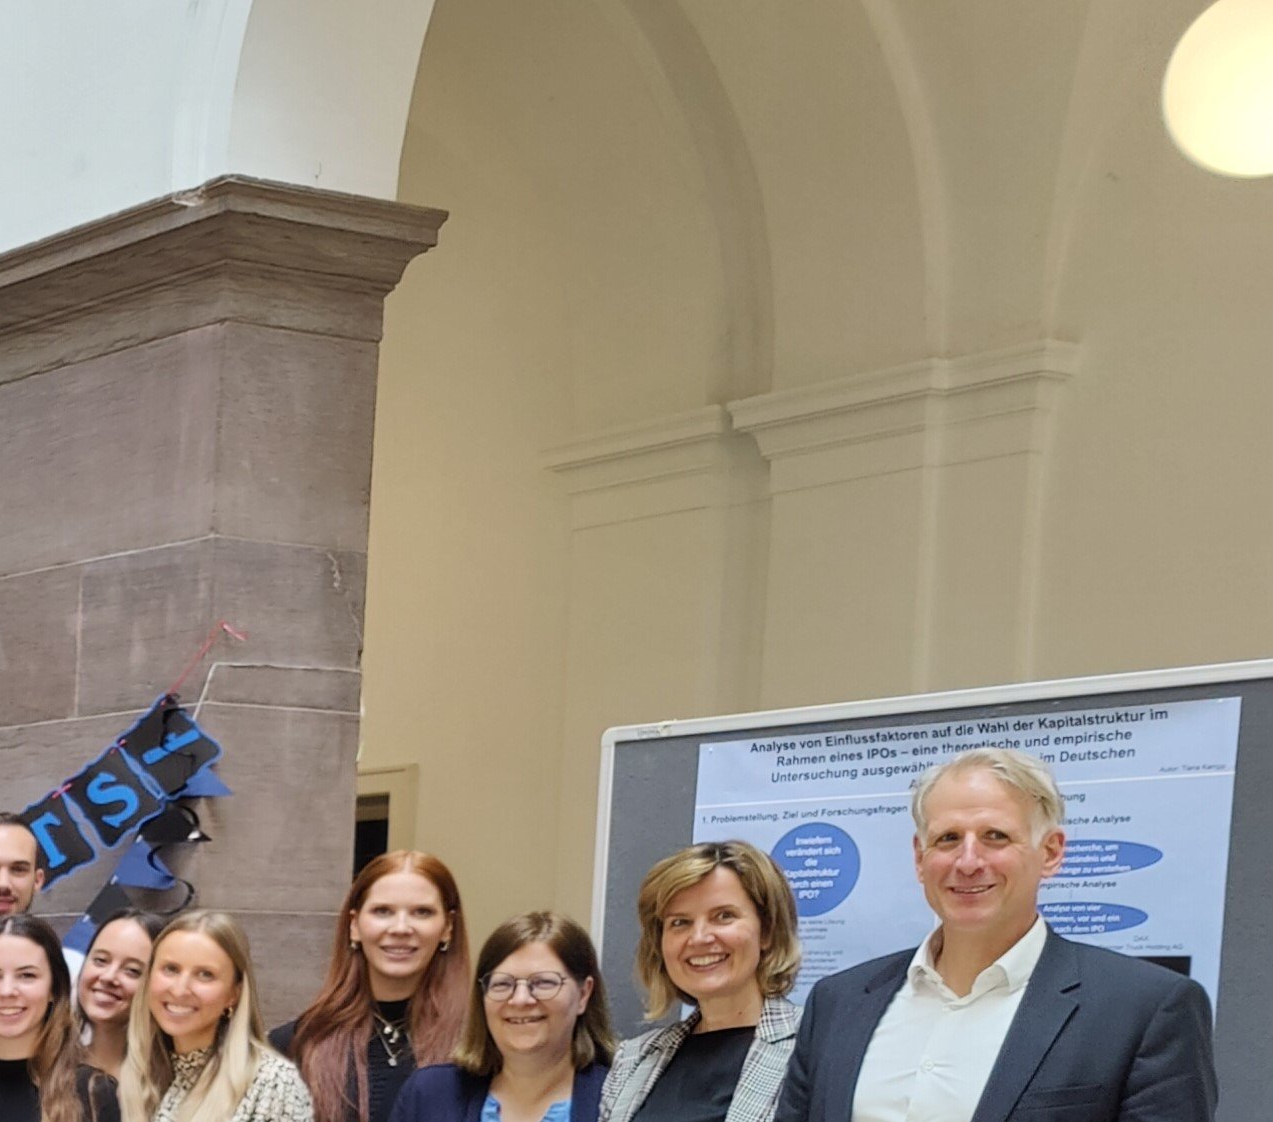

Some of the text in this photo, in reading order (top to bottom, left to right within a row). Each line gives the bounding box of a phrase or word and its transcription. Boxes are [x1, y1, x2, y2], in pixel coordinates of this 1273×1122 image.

[750, 709, 1169, 754] Analyse von Einflussfaktoren auf die Wahl der Kapitalstruktur im
[776, 754, 826, 767] Rahmen
[829, 751, 863, 763] eines
[866, 747, 897, 760] IPOs
[912, 745, 939, 756] eine
[1025, 735, 1050, 748] und
[1054, 730, 1133, 746] empirische
[771, 766, 858, 783] Untersuchung
[1059, 747, 1135, 763] Deutschen
[782, 810, 799, 819] Ziel
[800, 808, 819, 818] und
[821, 804, 908, 818] Forschungsfragen
[1091, 814, 1132, 824] Analyse
[1039, 880, 1117, 890] mpirische Analyse
